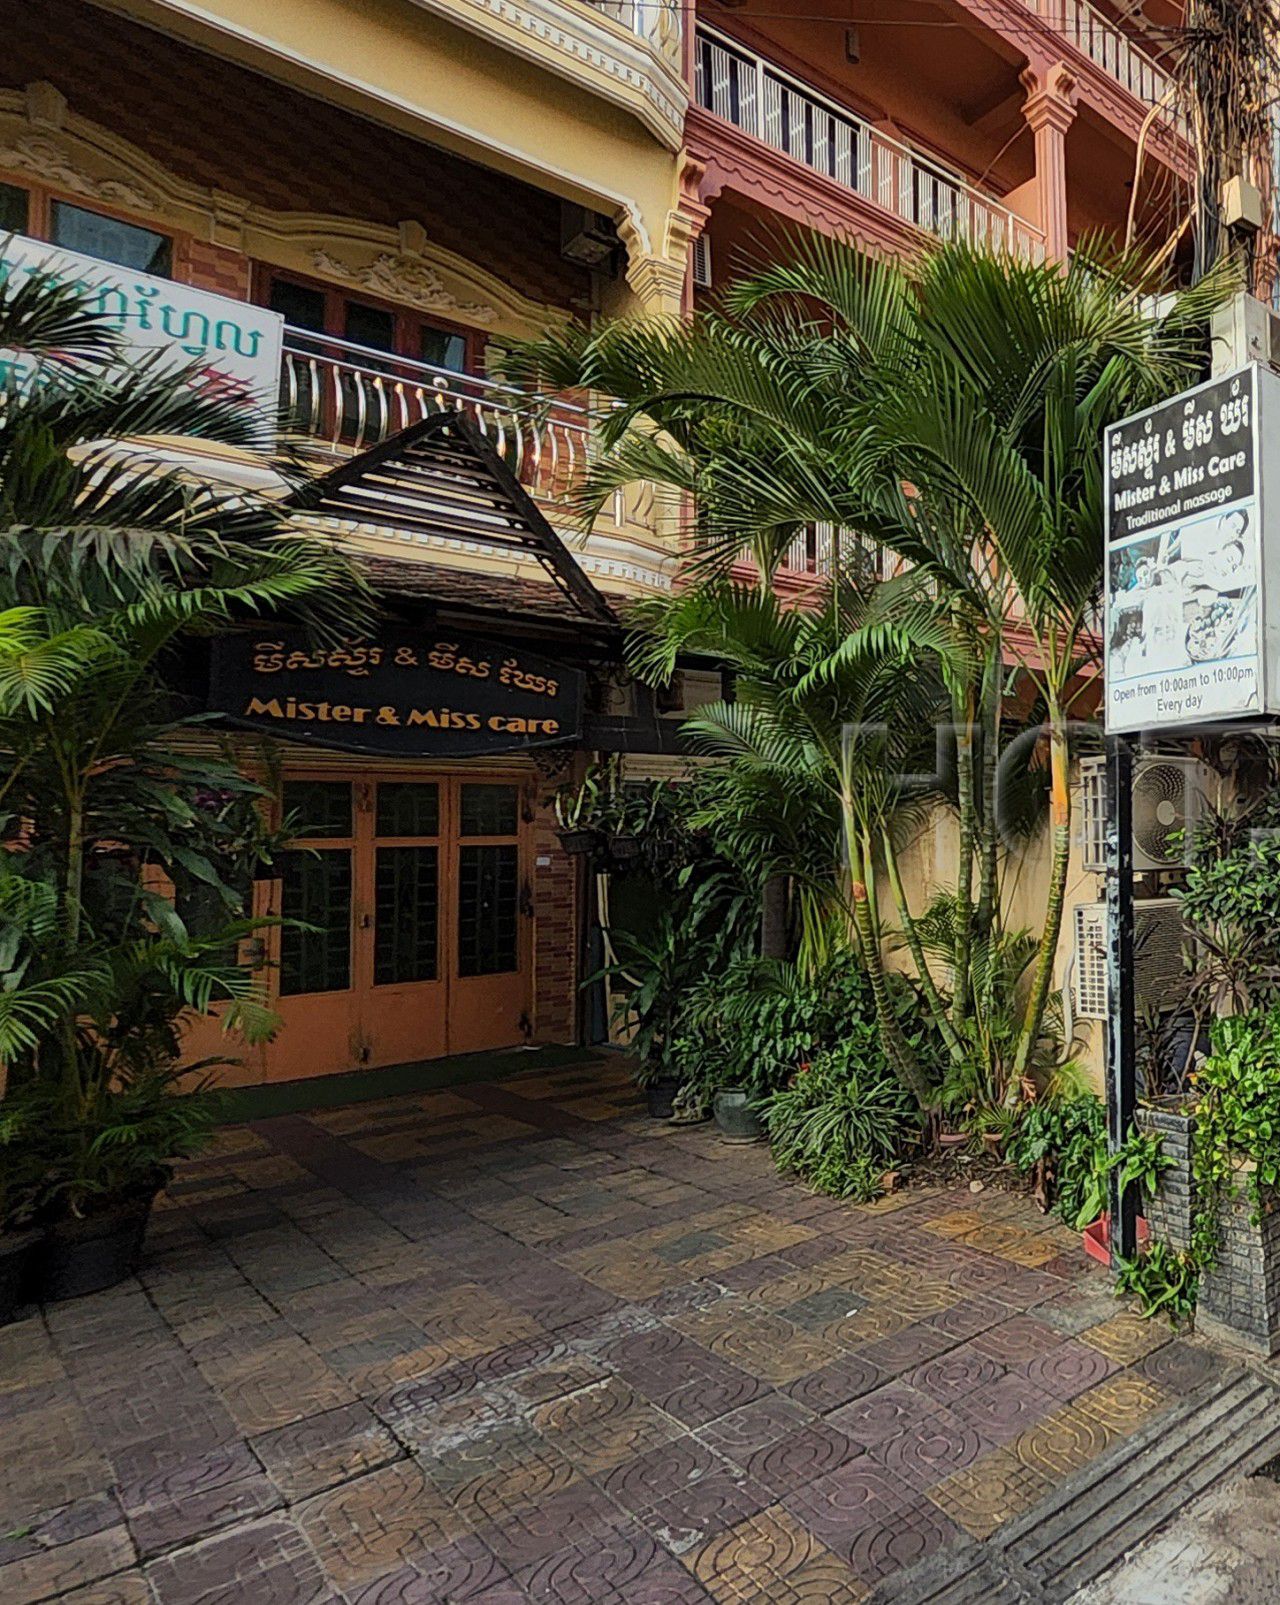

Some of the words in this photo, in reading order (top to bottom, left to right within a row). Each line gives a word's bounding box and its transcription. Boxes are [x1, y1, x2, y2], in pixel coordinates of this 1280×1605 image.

[1114, 484, 1156, 512] Mister
[1159, 475, 1171, 496] &
[1173, 465, 1205, 491] Miss
[1207, 450, 1246, 477] Care
[1126, 498, 1181, 530] Traditional
[1183, 485, 1233, 511] massage
[394, 647, 419, 667] &
[1113, 686, 1136, 704] Open
[1137, 681, 1157, 697] from
[1199, 671, 1210, 686] to
[1212, 665, 1254, 683] 10:00pm
[1157, 696, 1183, 714] Every
[1185, 692, 1204, 709] day
[243, 696, 373, 723] Mister
[374, 705, 401, 726] &
[406, 707, 481, 730] Miss
[487, 714, 561, 735] care
